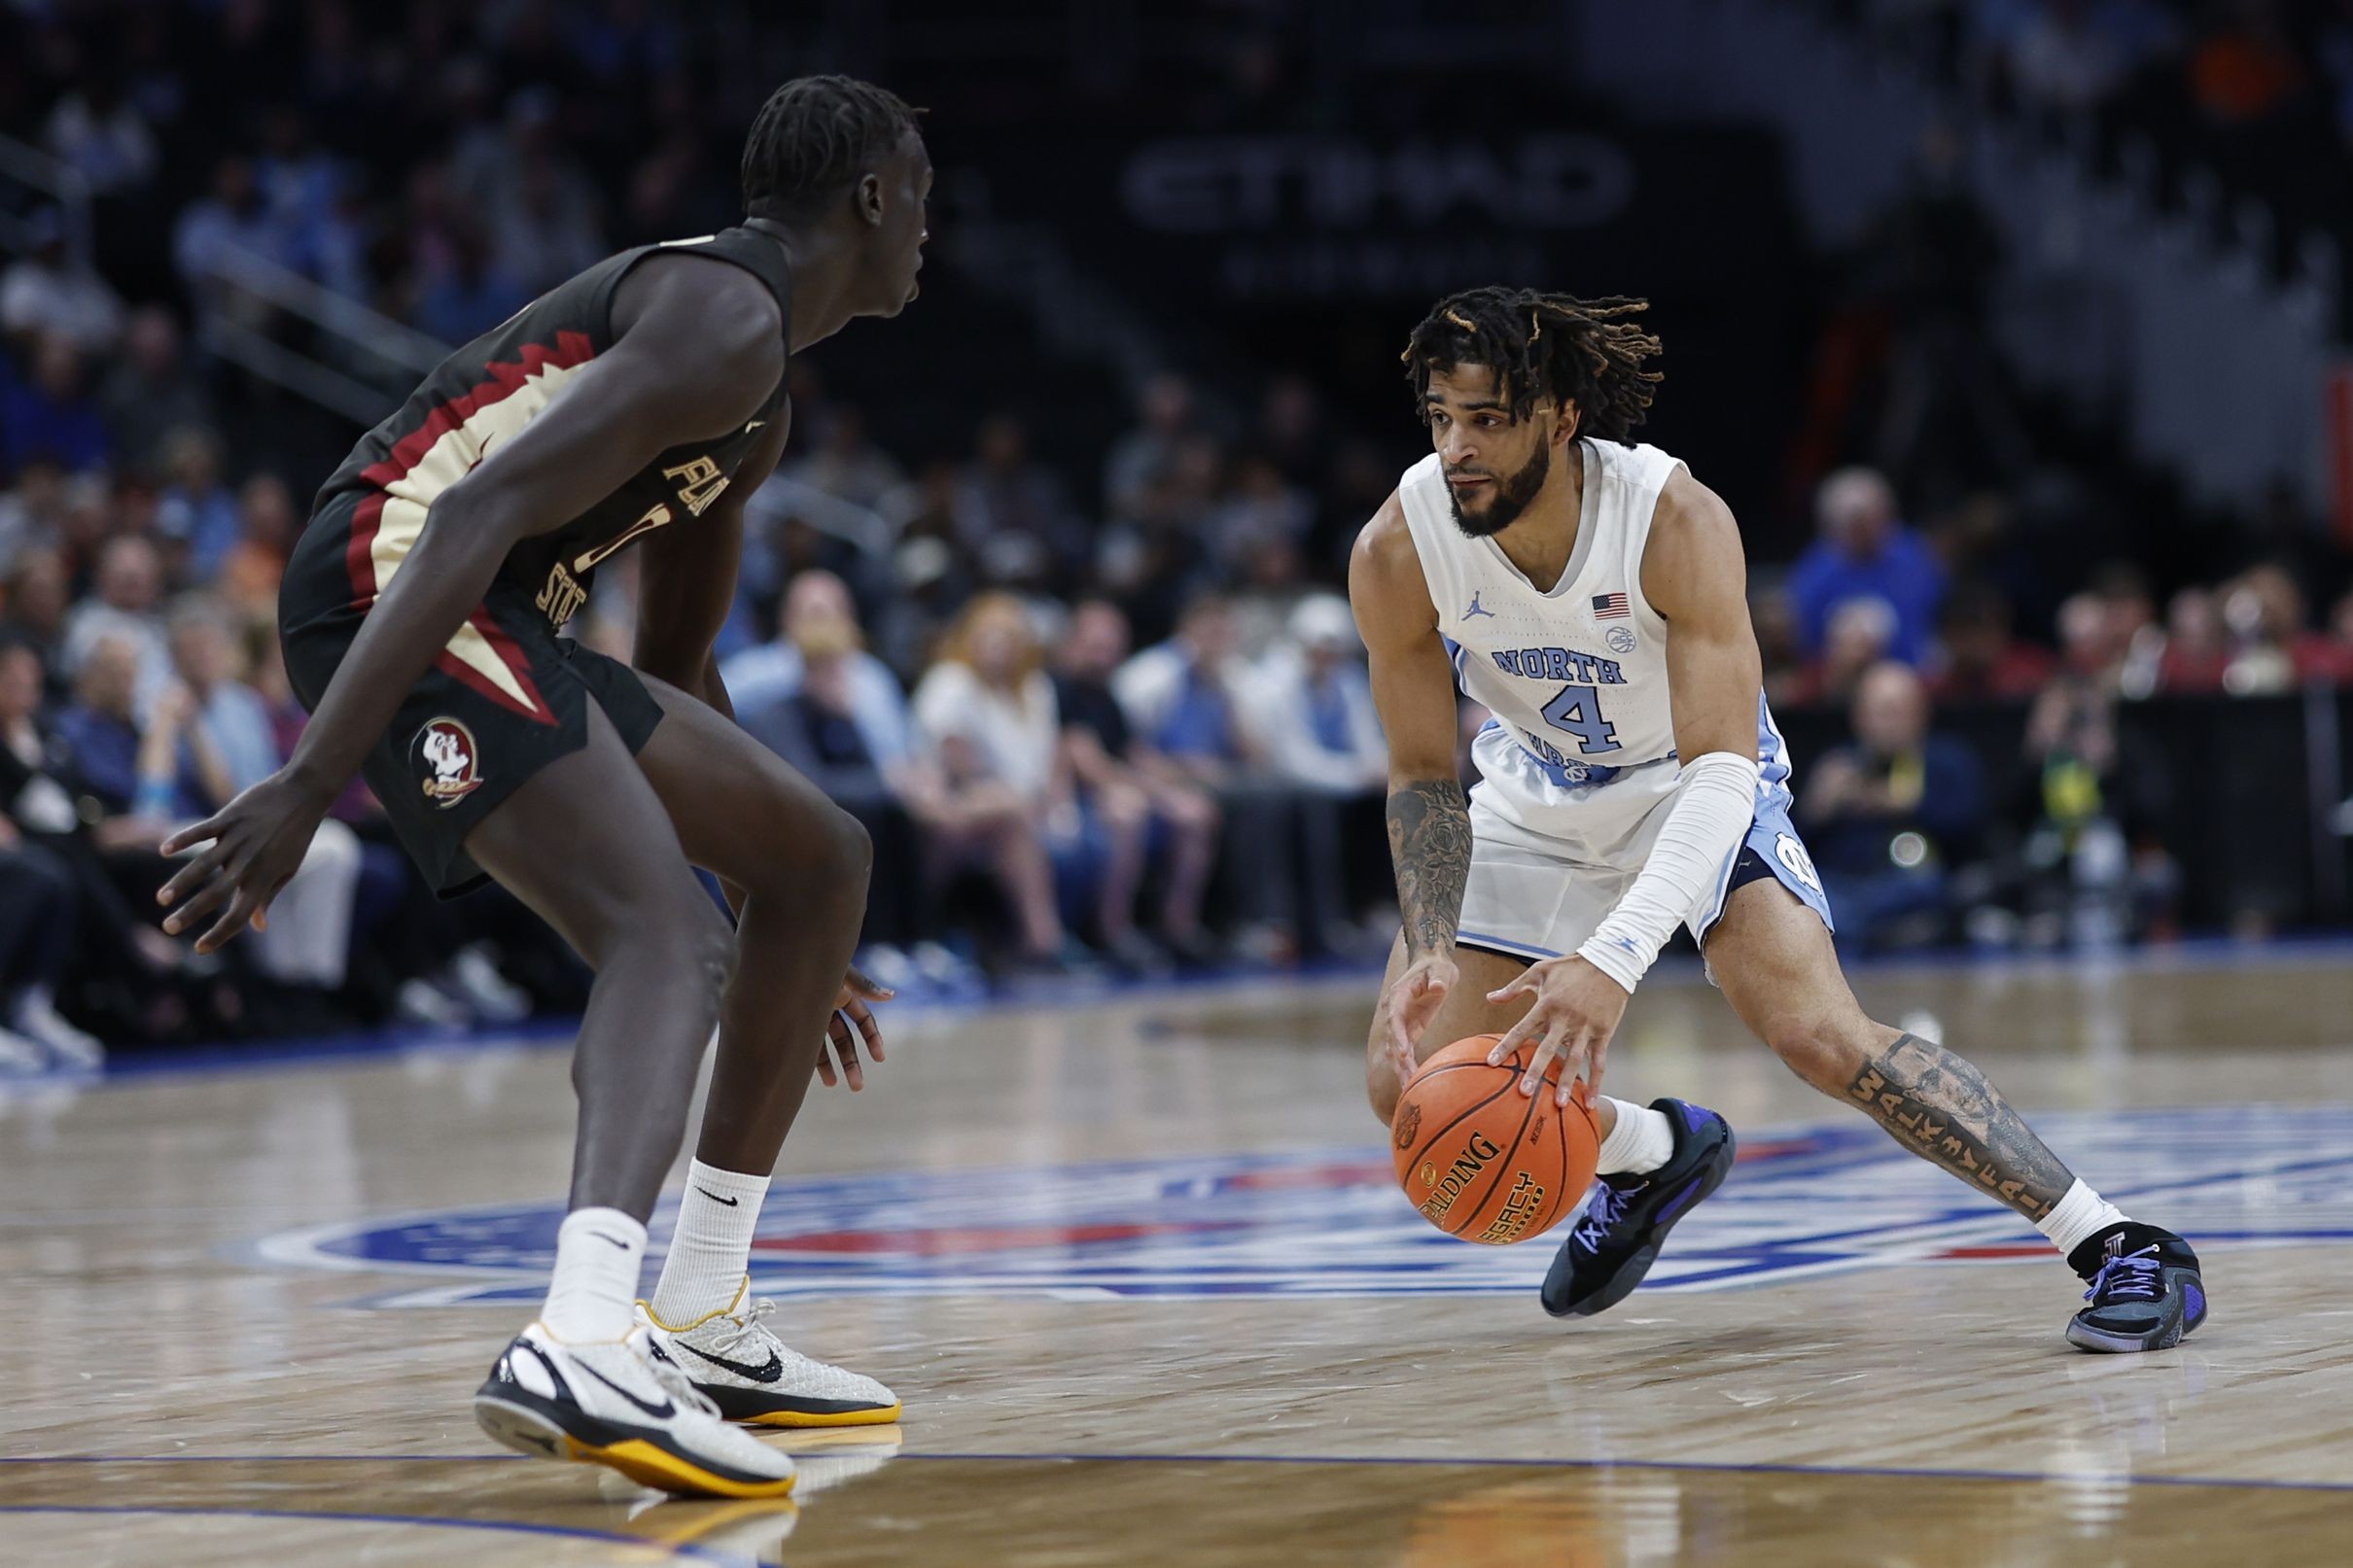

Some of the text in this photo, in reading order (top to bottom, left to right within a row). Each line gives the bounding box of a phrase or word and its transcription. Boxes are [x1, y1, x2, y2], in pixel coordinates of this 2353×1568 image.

[1492, 646, 1628, 684] NORTH
[1540, 684, 1623, 754] 4
[1850, 1069, 2052, 1218] WALK BY FAIT
[1418, 1131, 1501, 1229] PALDING
[1478, 1170, 1534, 1241] EGACY
